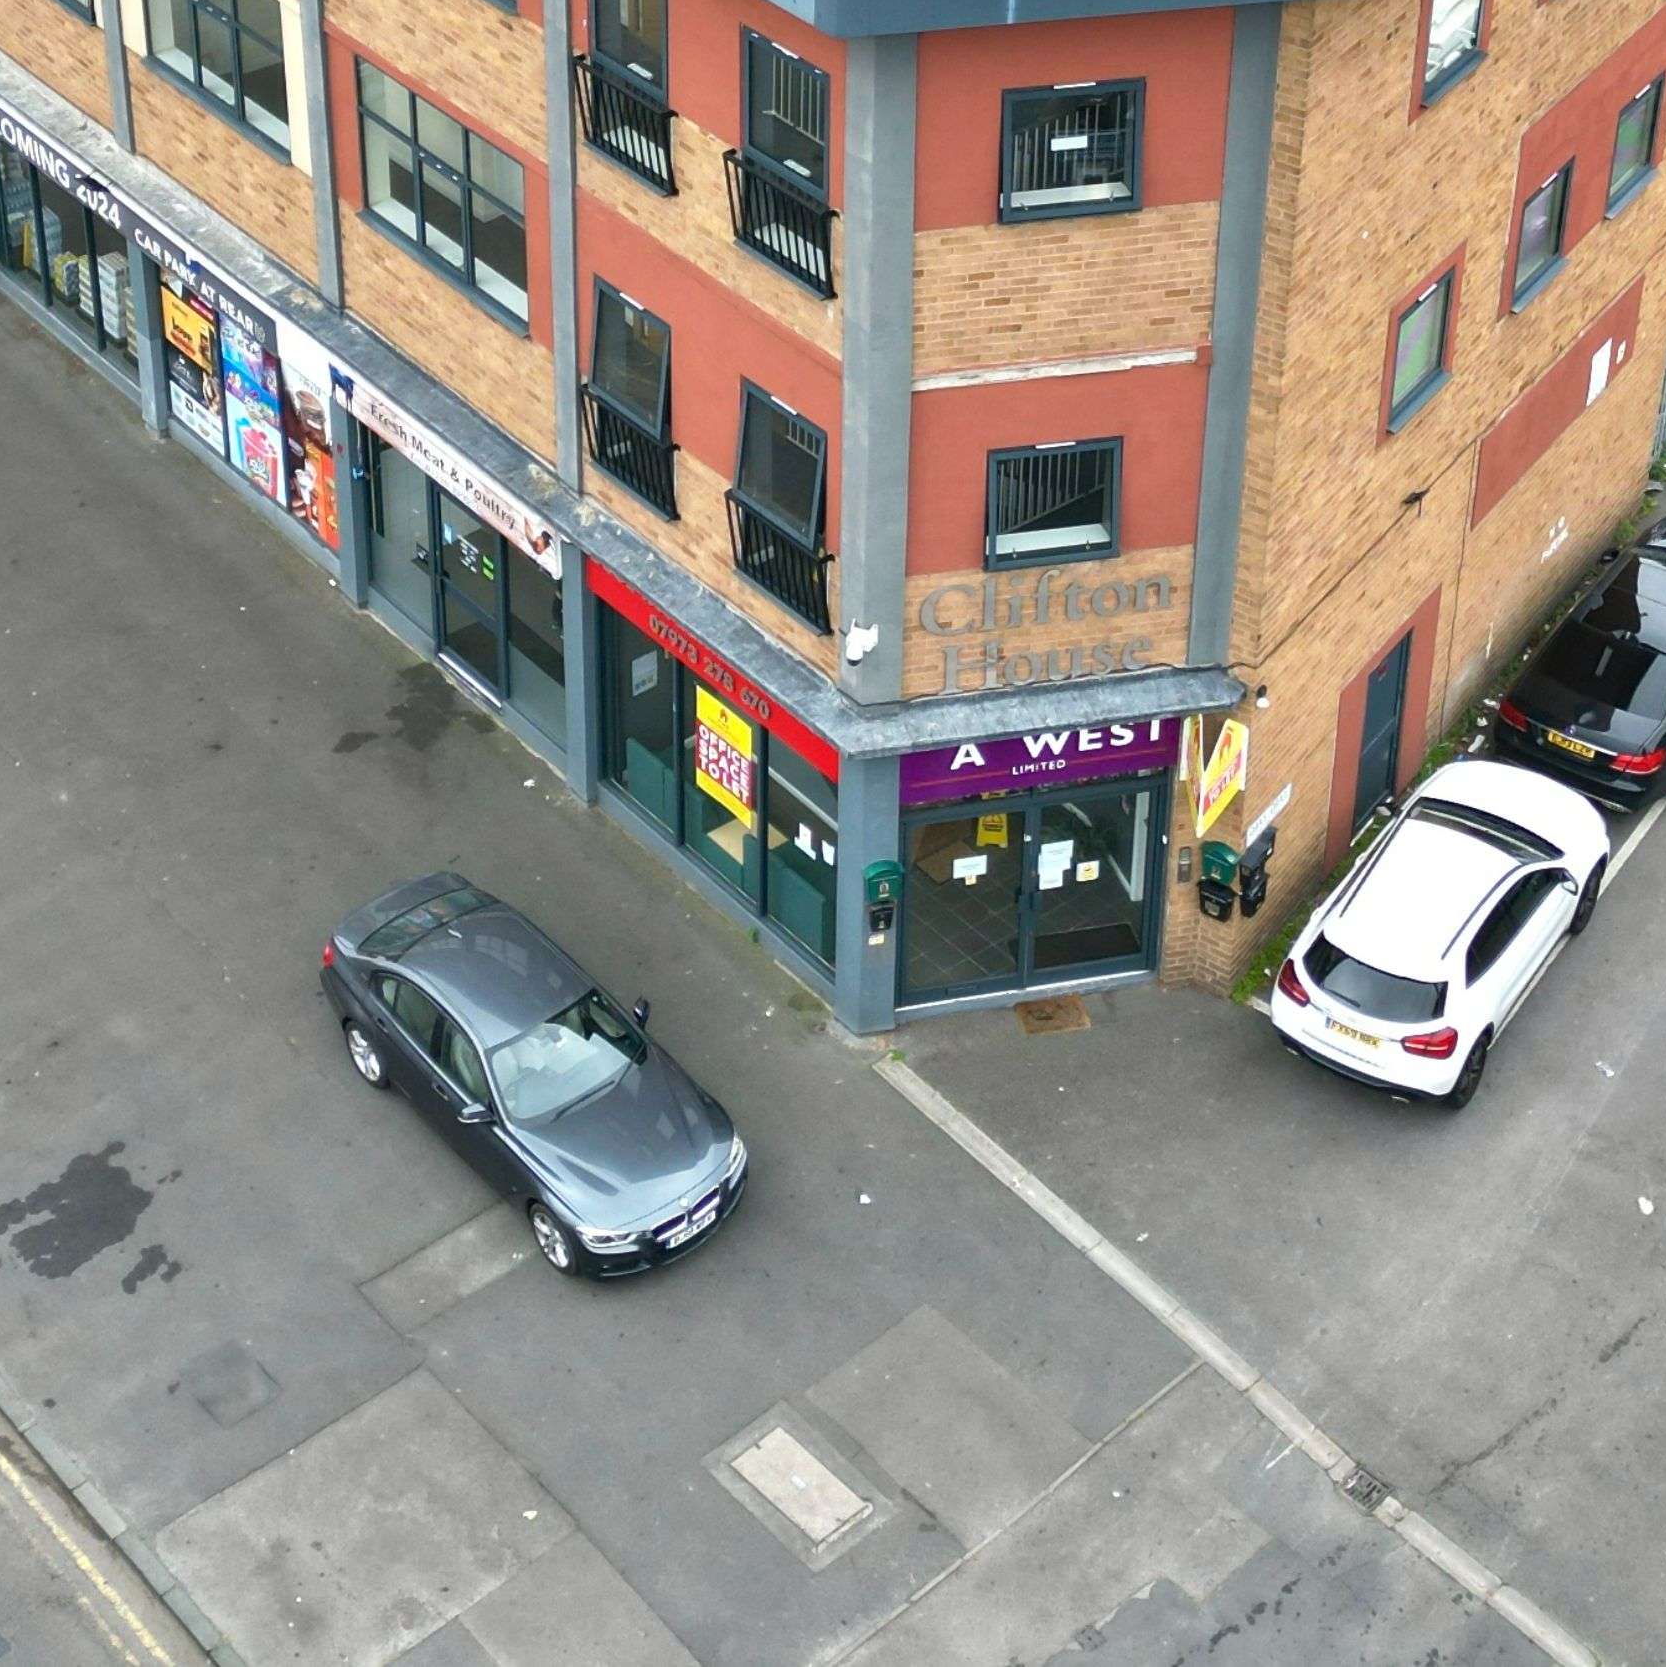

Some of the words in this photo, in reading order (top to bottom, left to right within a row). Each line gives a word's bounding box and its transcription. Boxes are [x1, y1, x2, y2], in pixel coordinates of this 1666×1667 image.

[134, 228, 162, 262] CAR
[164, 253, 197, 287] PARK
[200, 280, 216, 304] AT
[218, 293, 255, 337] REAR
[411, 434, 449, 474] Meat
[449, 468, 460, 484] &
[465, 477, 516, 530] Poultry
[919, 569, 1175, 635] Clifton
[649, 614, 700, 664] 07973
[703, 656, 735, 692] 278
[741, 685, 772, 721] 670
[939, 634, 1152, 695] House
[698, 724, 750, 771] OFFICE
[699, 740, 750, 790] SPACE
[950, 743, 985, 771] A
[1022, 719, 1162, 760] WEST
[1011, 759, 1066, 776] LIMITED
[699, 755, 721, 780] TO
[721, 771, 750, 805] LET
